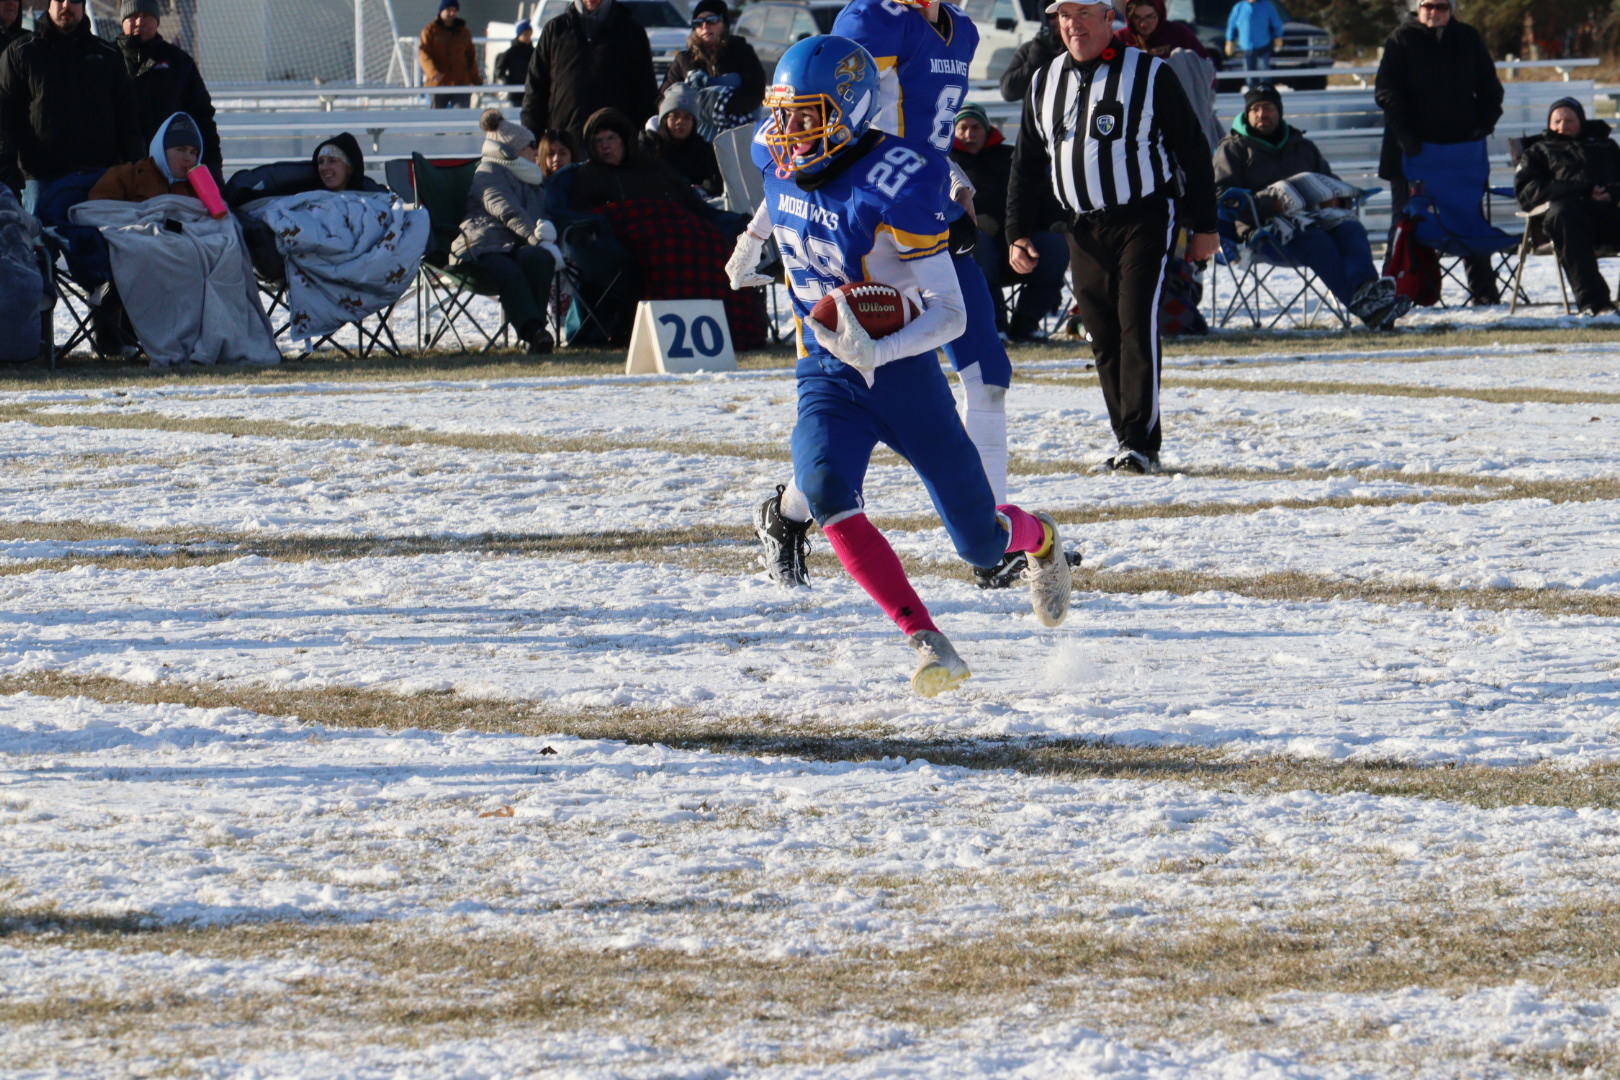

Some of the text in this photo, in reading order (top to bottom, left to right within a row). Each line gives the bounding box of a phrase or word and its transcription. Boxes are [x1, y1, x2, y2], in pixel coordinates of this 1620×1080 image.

[928, 84, 962, 152] 6
[866, 146, 927, 199] 29
[778, 193, 839, 231] MOHAWKS
[773, 223, 851, 303] 29
[858, 302, 896, 312] Wilson
[659, 313, 724, 358] 20
